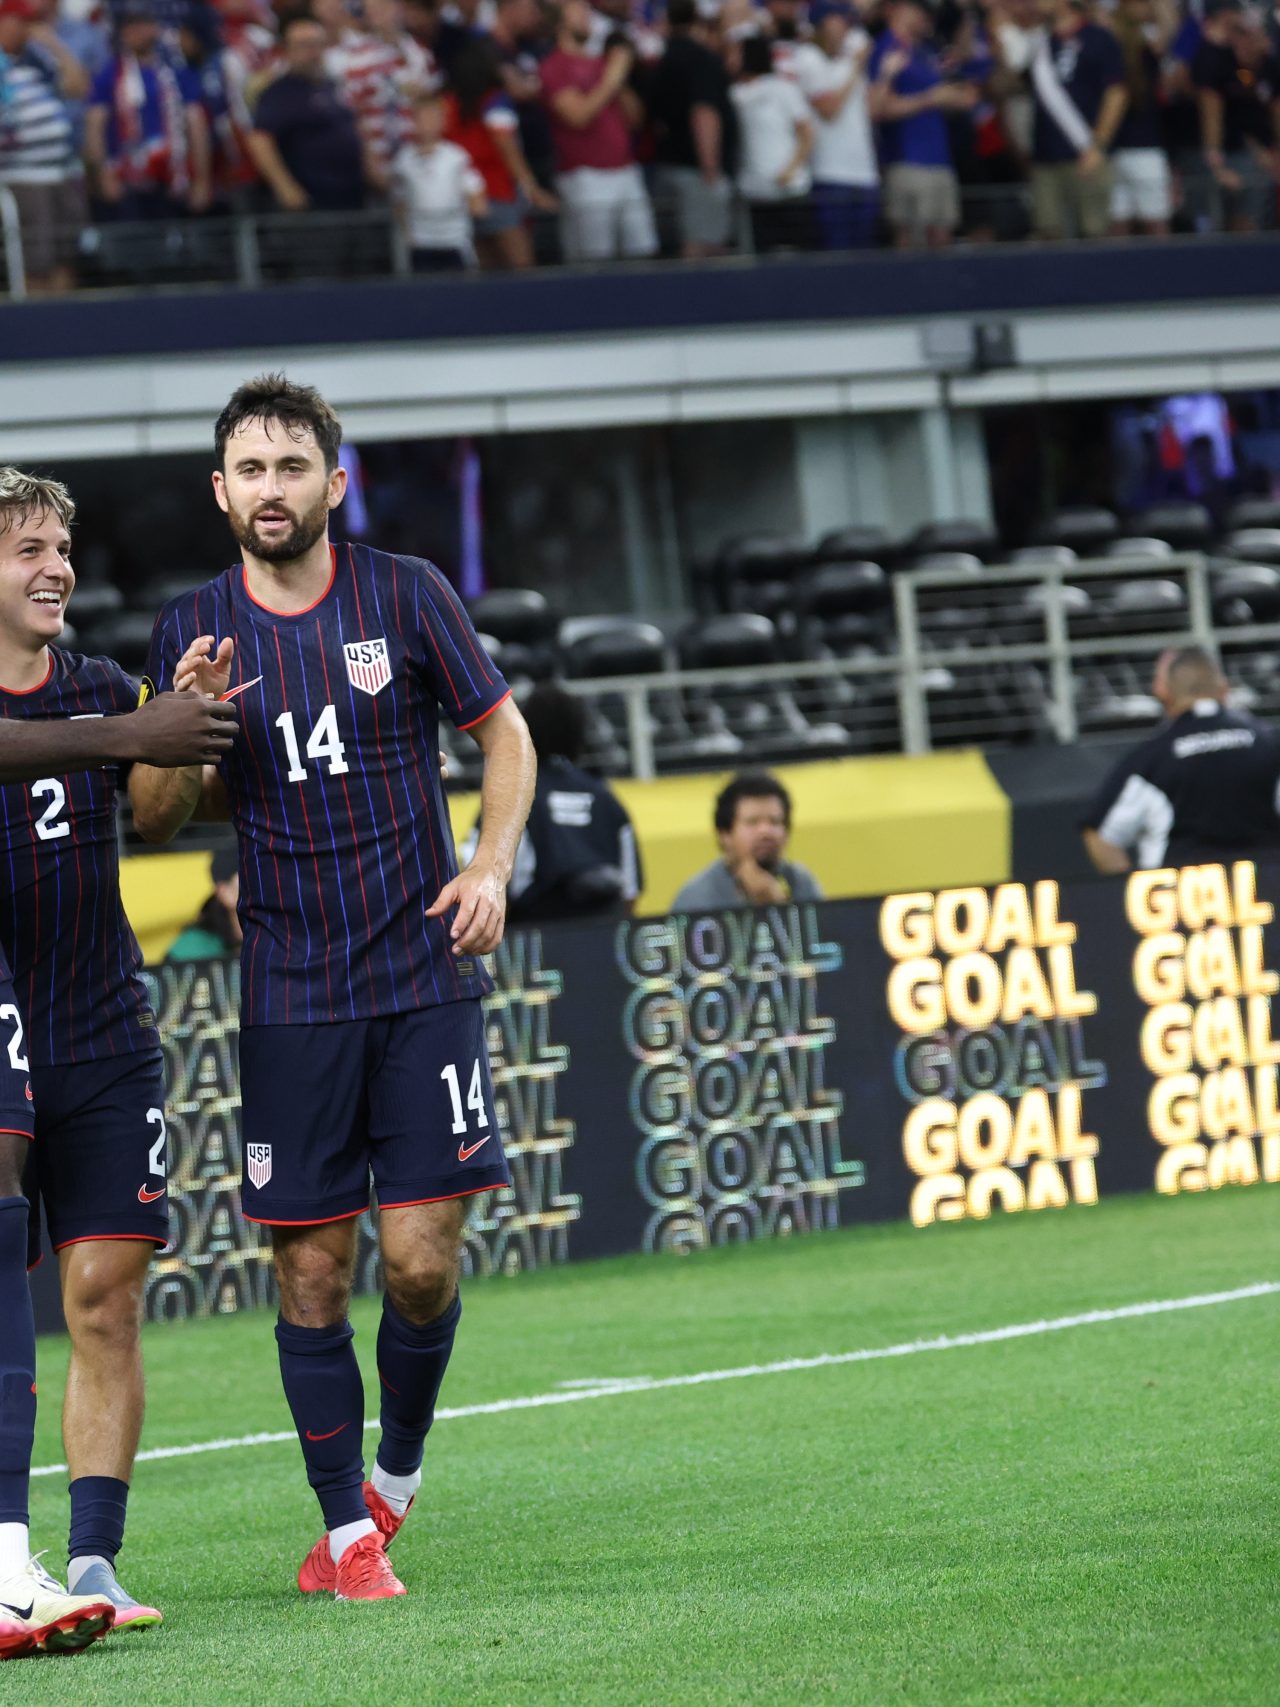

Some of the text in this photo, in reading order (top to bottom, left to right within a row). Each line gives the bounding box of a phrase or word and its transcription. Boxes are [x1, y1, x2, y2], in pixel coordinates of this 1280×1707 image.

[346, 641, 385, 665] USA
[274, 704, 350, 783] 14
[31, 777, 71, 841] 2
[614, 903, 845, 990] GOAL
[878, 878, 1078, 963] GOAL
[622, 972, 838, 1065] GOAL
[887, 944, 1101, 1038] GOAL
[439, 1057, 489, 1135] 14
[629, 1046, 846, 1138] GOAL
[893, 1014, 1111, 1104] GOAL
[146, 1107, 167, 1178] 2
[249, 1145, 270, 1163] USA
[635, 1114, 867, 1212] GOAL
[902, 1085, 1101, 1176] GOAL
